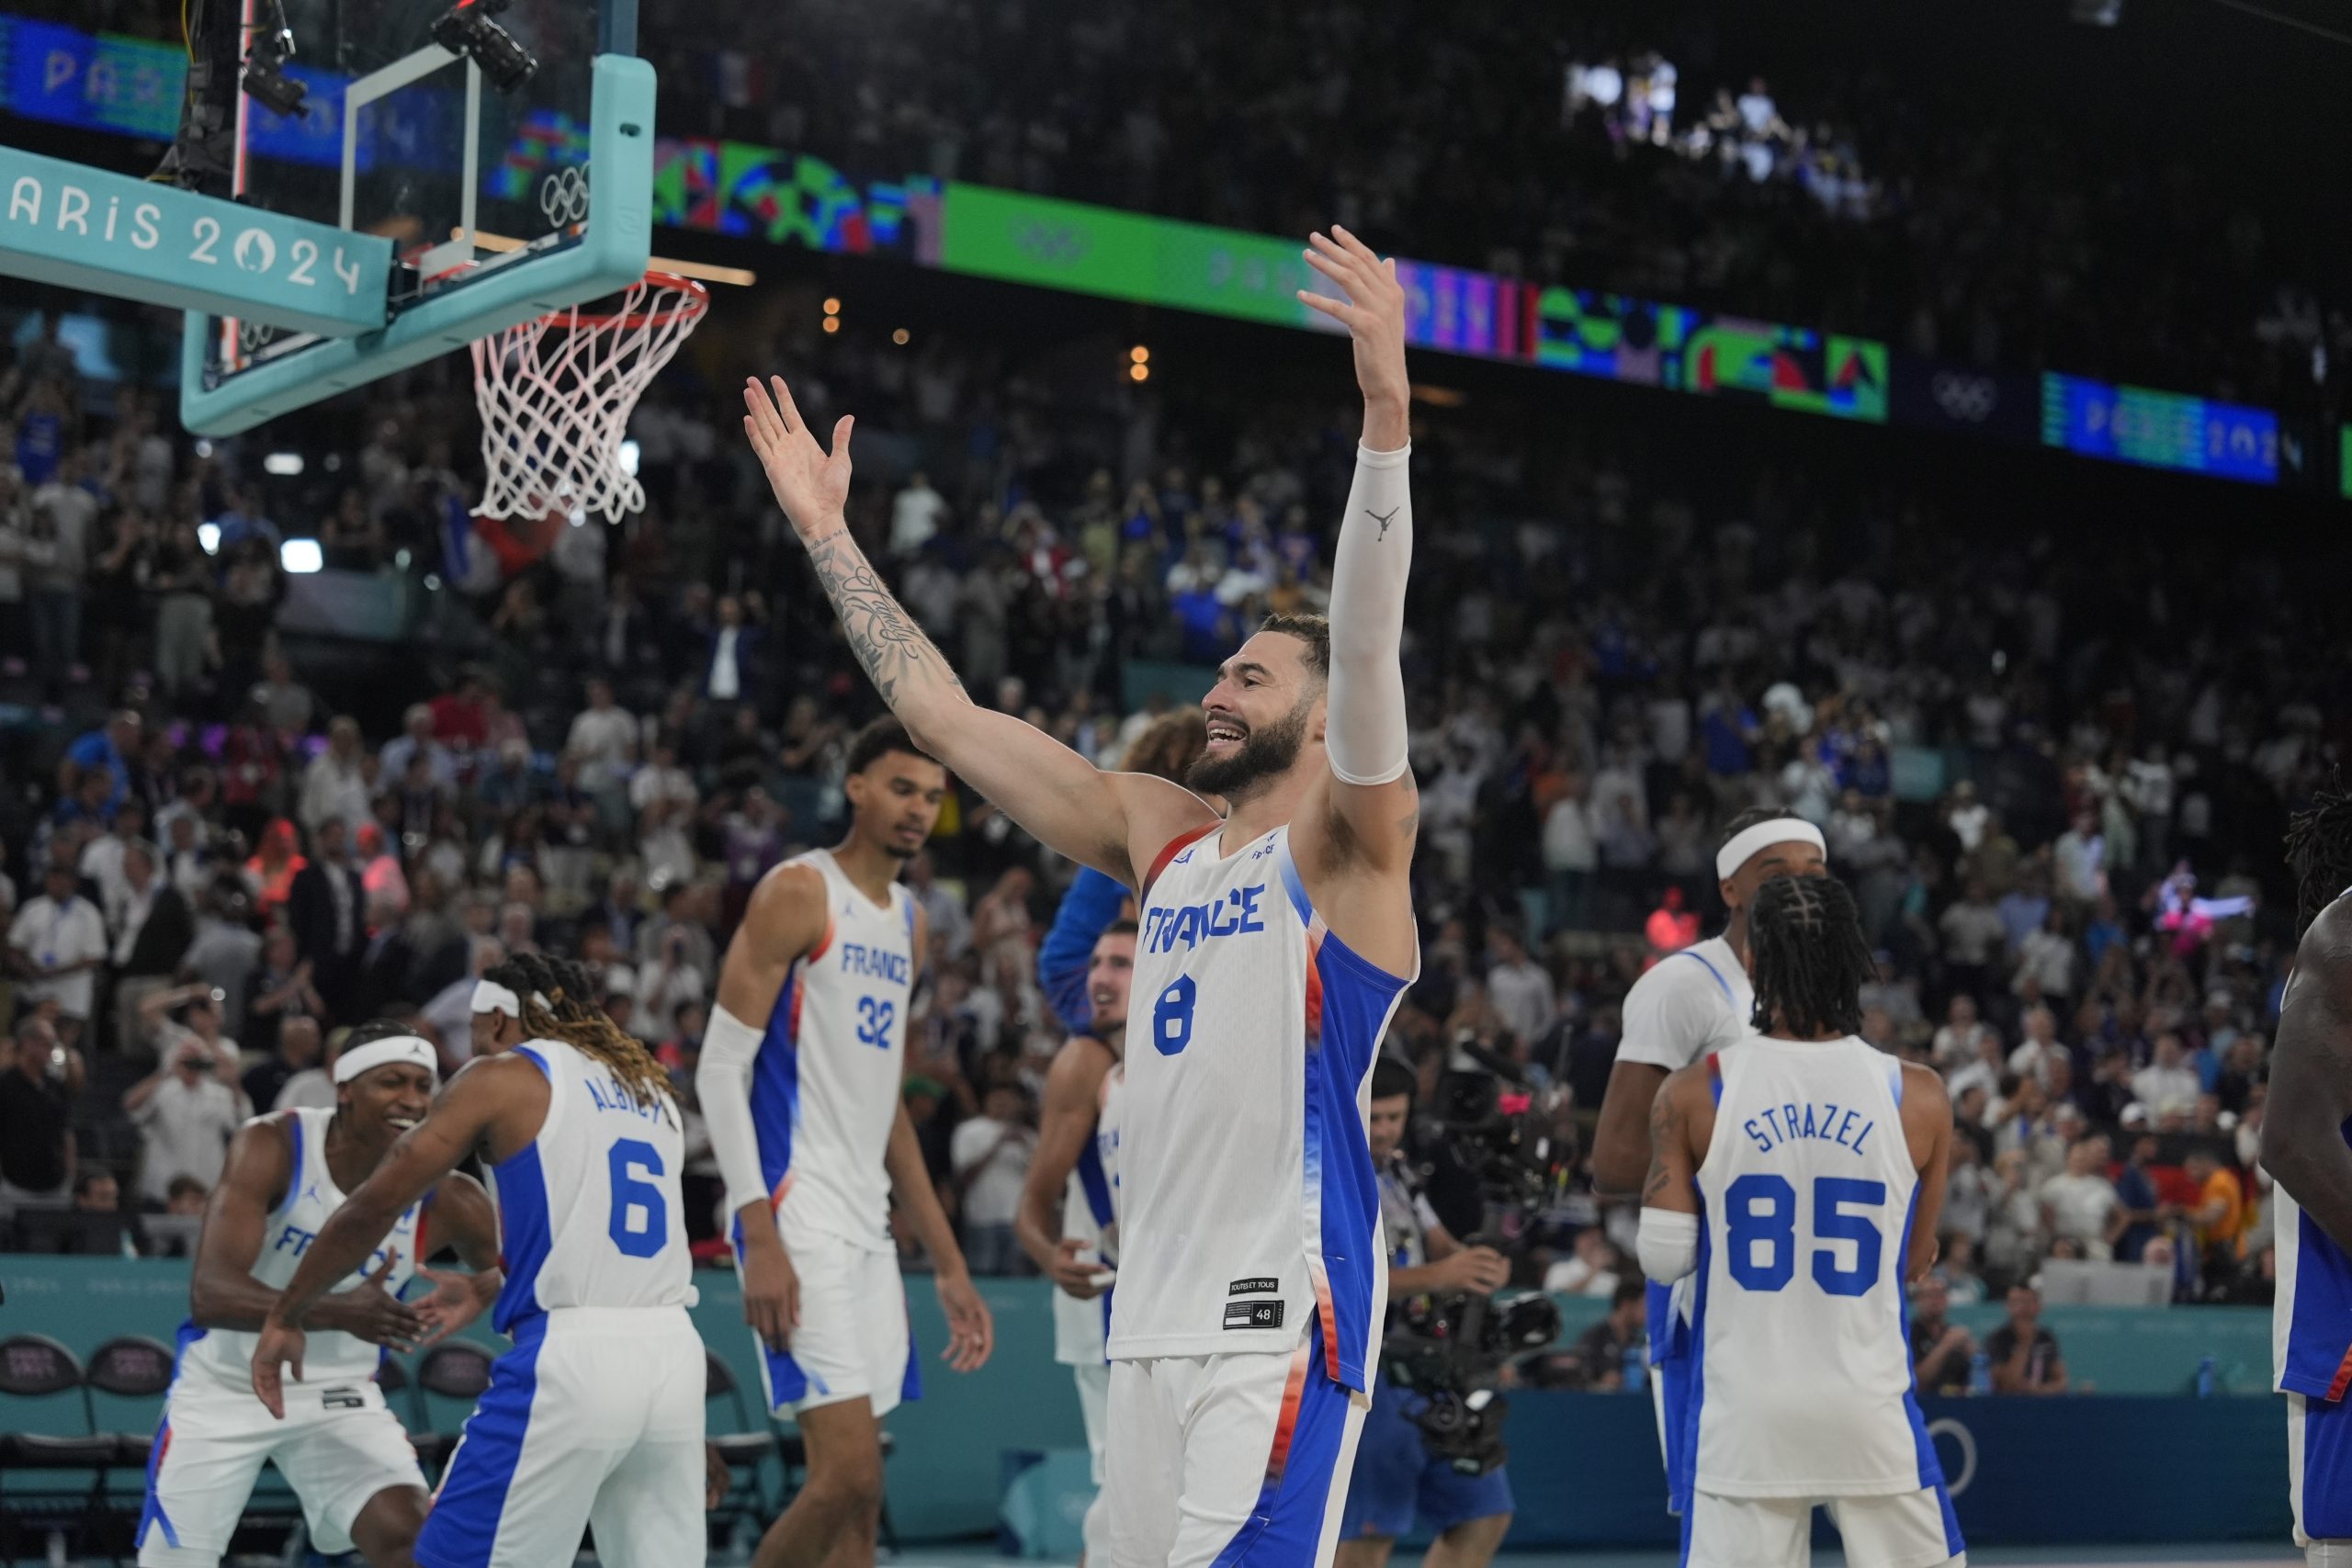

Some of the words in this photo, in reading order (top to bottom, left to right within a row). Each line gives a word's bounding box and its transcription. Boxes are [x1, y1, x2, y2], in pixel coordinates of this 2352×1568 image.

[189, 217, 360, 295] 2024
[842, 942, 907, 986] FRANCE
[856, 996, 894, 1049] 32
[1153, 973, 1196, 1056] 8
[1744, 1103, 1873, 1156] STRAZEL
[608, 1137, 667, 1258] 6
[1724, 1174, 1886, 1297] 85
[1256, 1309, 1272, 1320] 48
